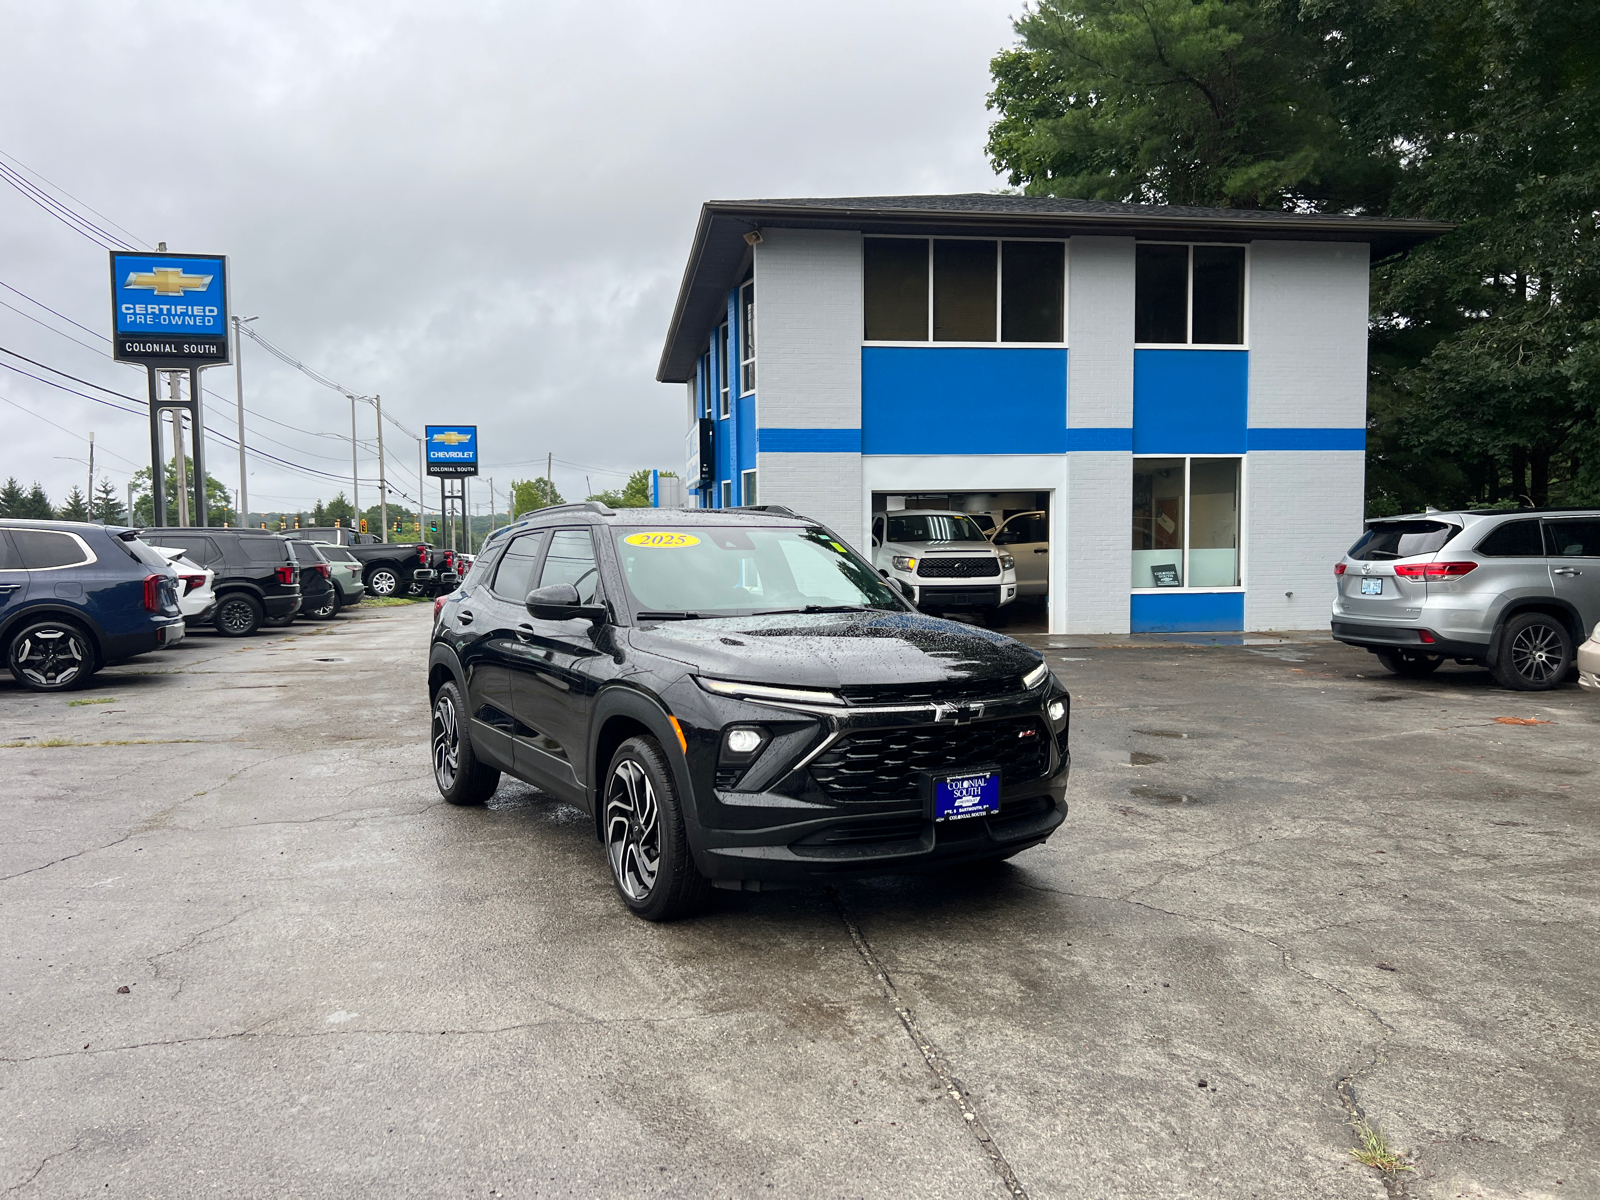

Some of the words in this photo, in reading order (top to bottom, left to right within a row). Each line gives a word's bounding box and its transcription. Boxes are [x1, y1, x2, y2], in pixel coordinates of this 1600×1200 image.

[121, 304, 218, 316] CERTIFIED
[126, 315, 214, 326] PRE-OWNED
[125, 342, 178, 353] COLONIAL
[183, 343, 217, 354] SOUTH
[639, 535, 687, 545] 2025
[947, 778, 988, 791] COLONIAL
[953, 786, 981, 798] SOUTH
[949, 813, 971, 821] COLONIAL
